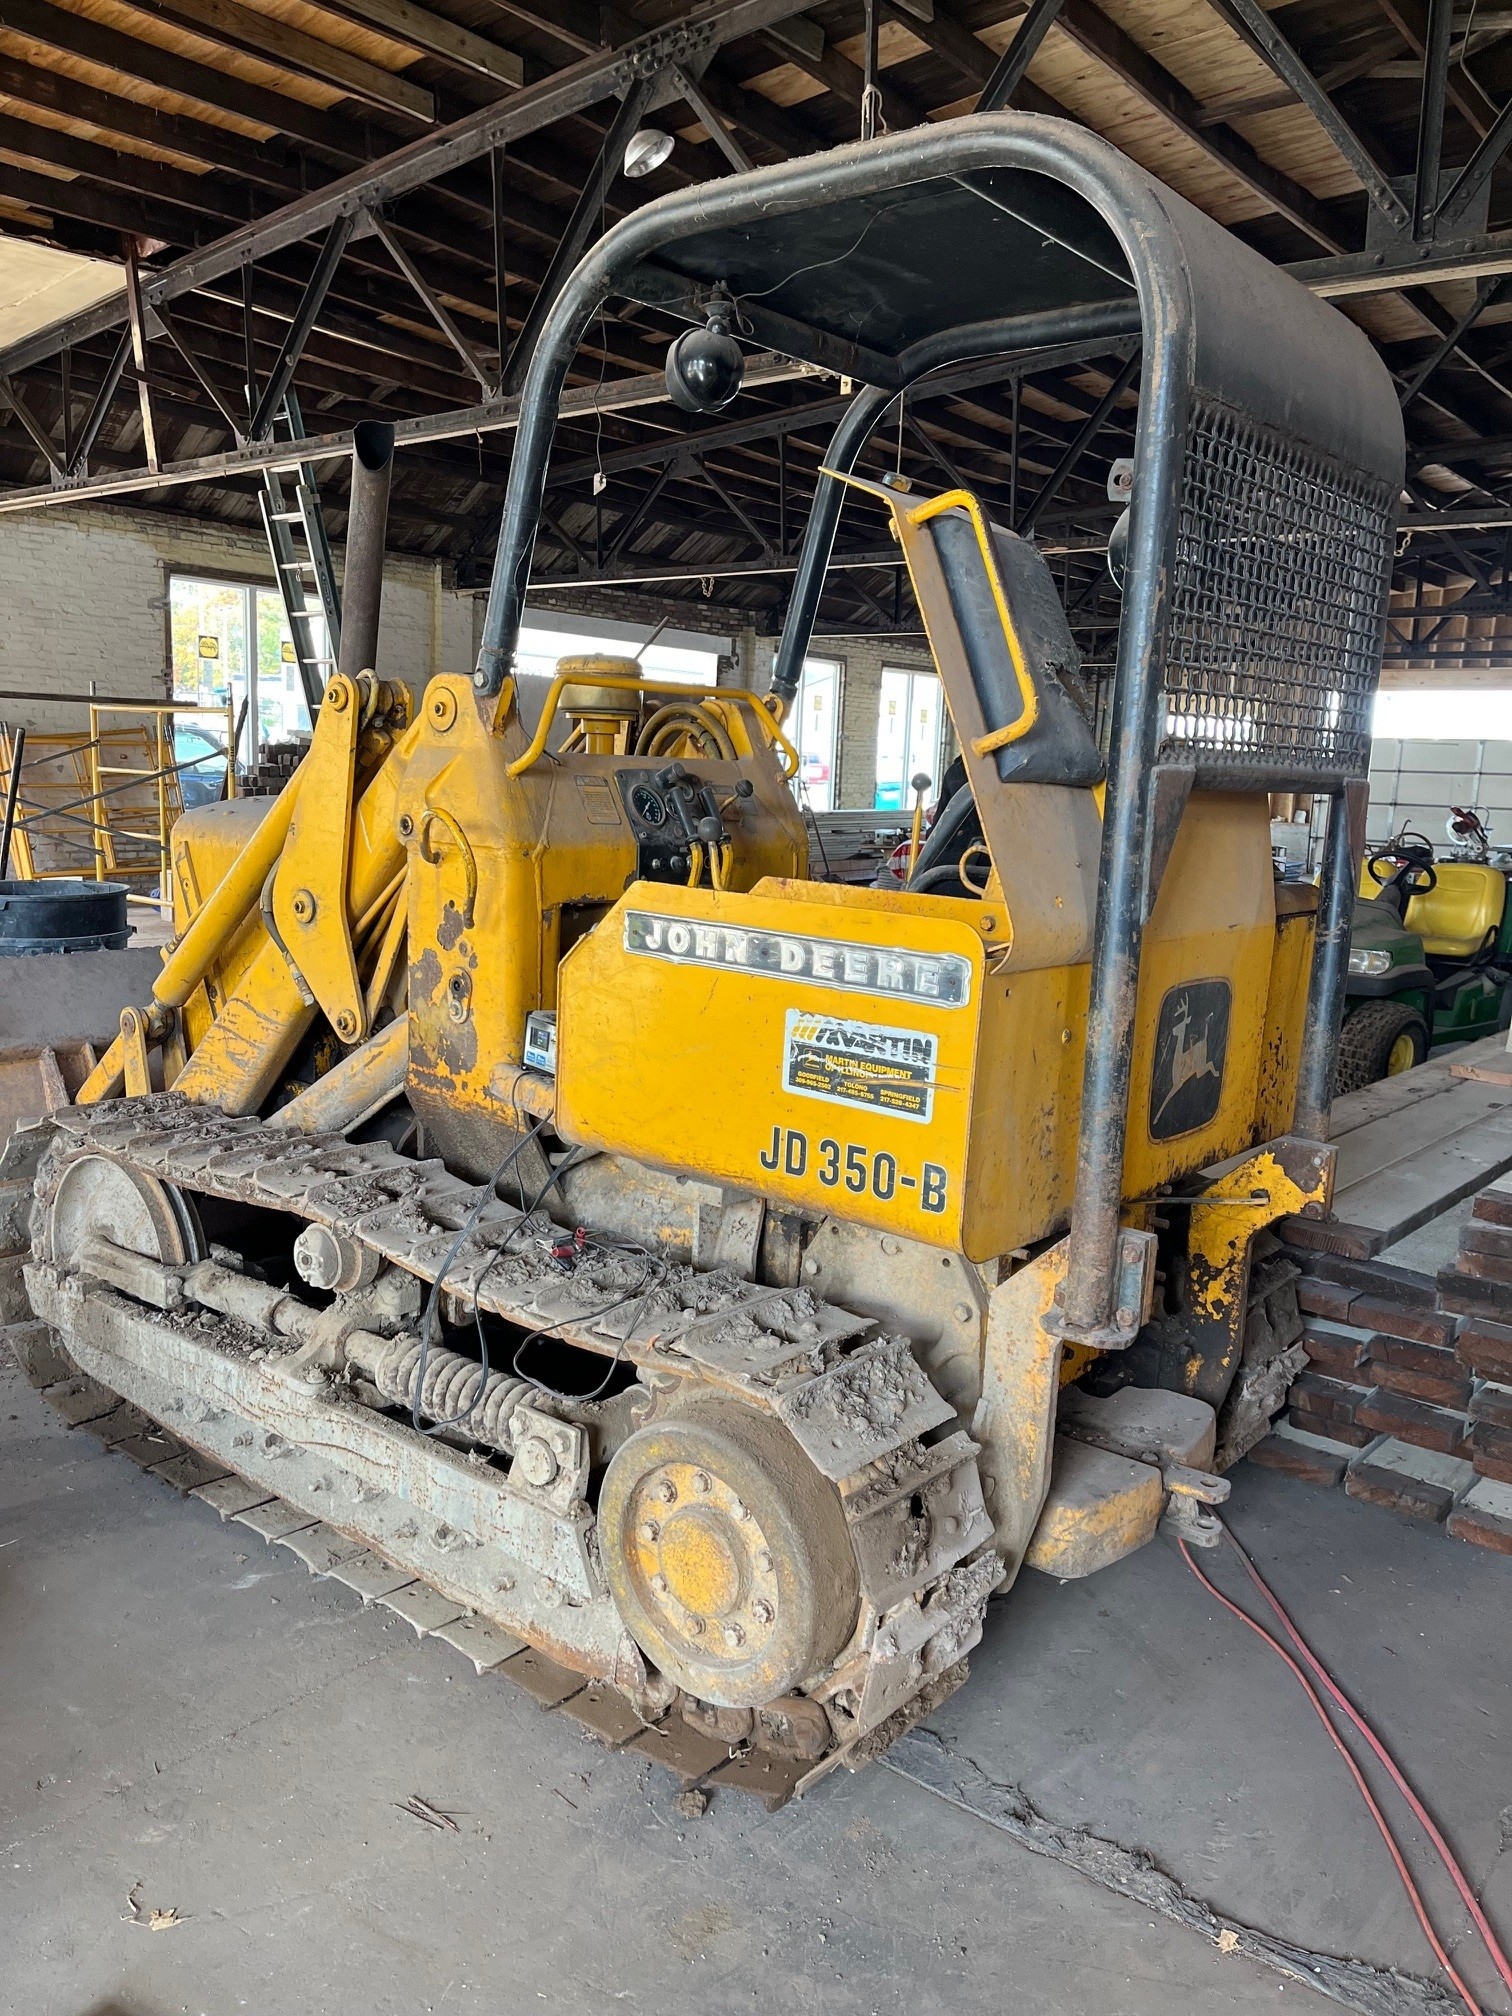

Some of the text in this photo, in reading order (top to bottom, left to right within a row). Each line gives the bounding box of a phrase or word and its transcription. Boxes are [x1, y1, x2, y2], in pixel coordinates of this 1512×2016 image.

[645, 919, 940, 996] JOHN DEERE
[825, 1054, 913, 1080] MARTIN EQUIPMENT
[844, 1081, 868, 1091] TOLONO
[880, 1089, 921, 1103] SPRINGFIELD
[760, 1126, 949, 1215] JD 350-B
